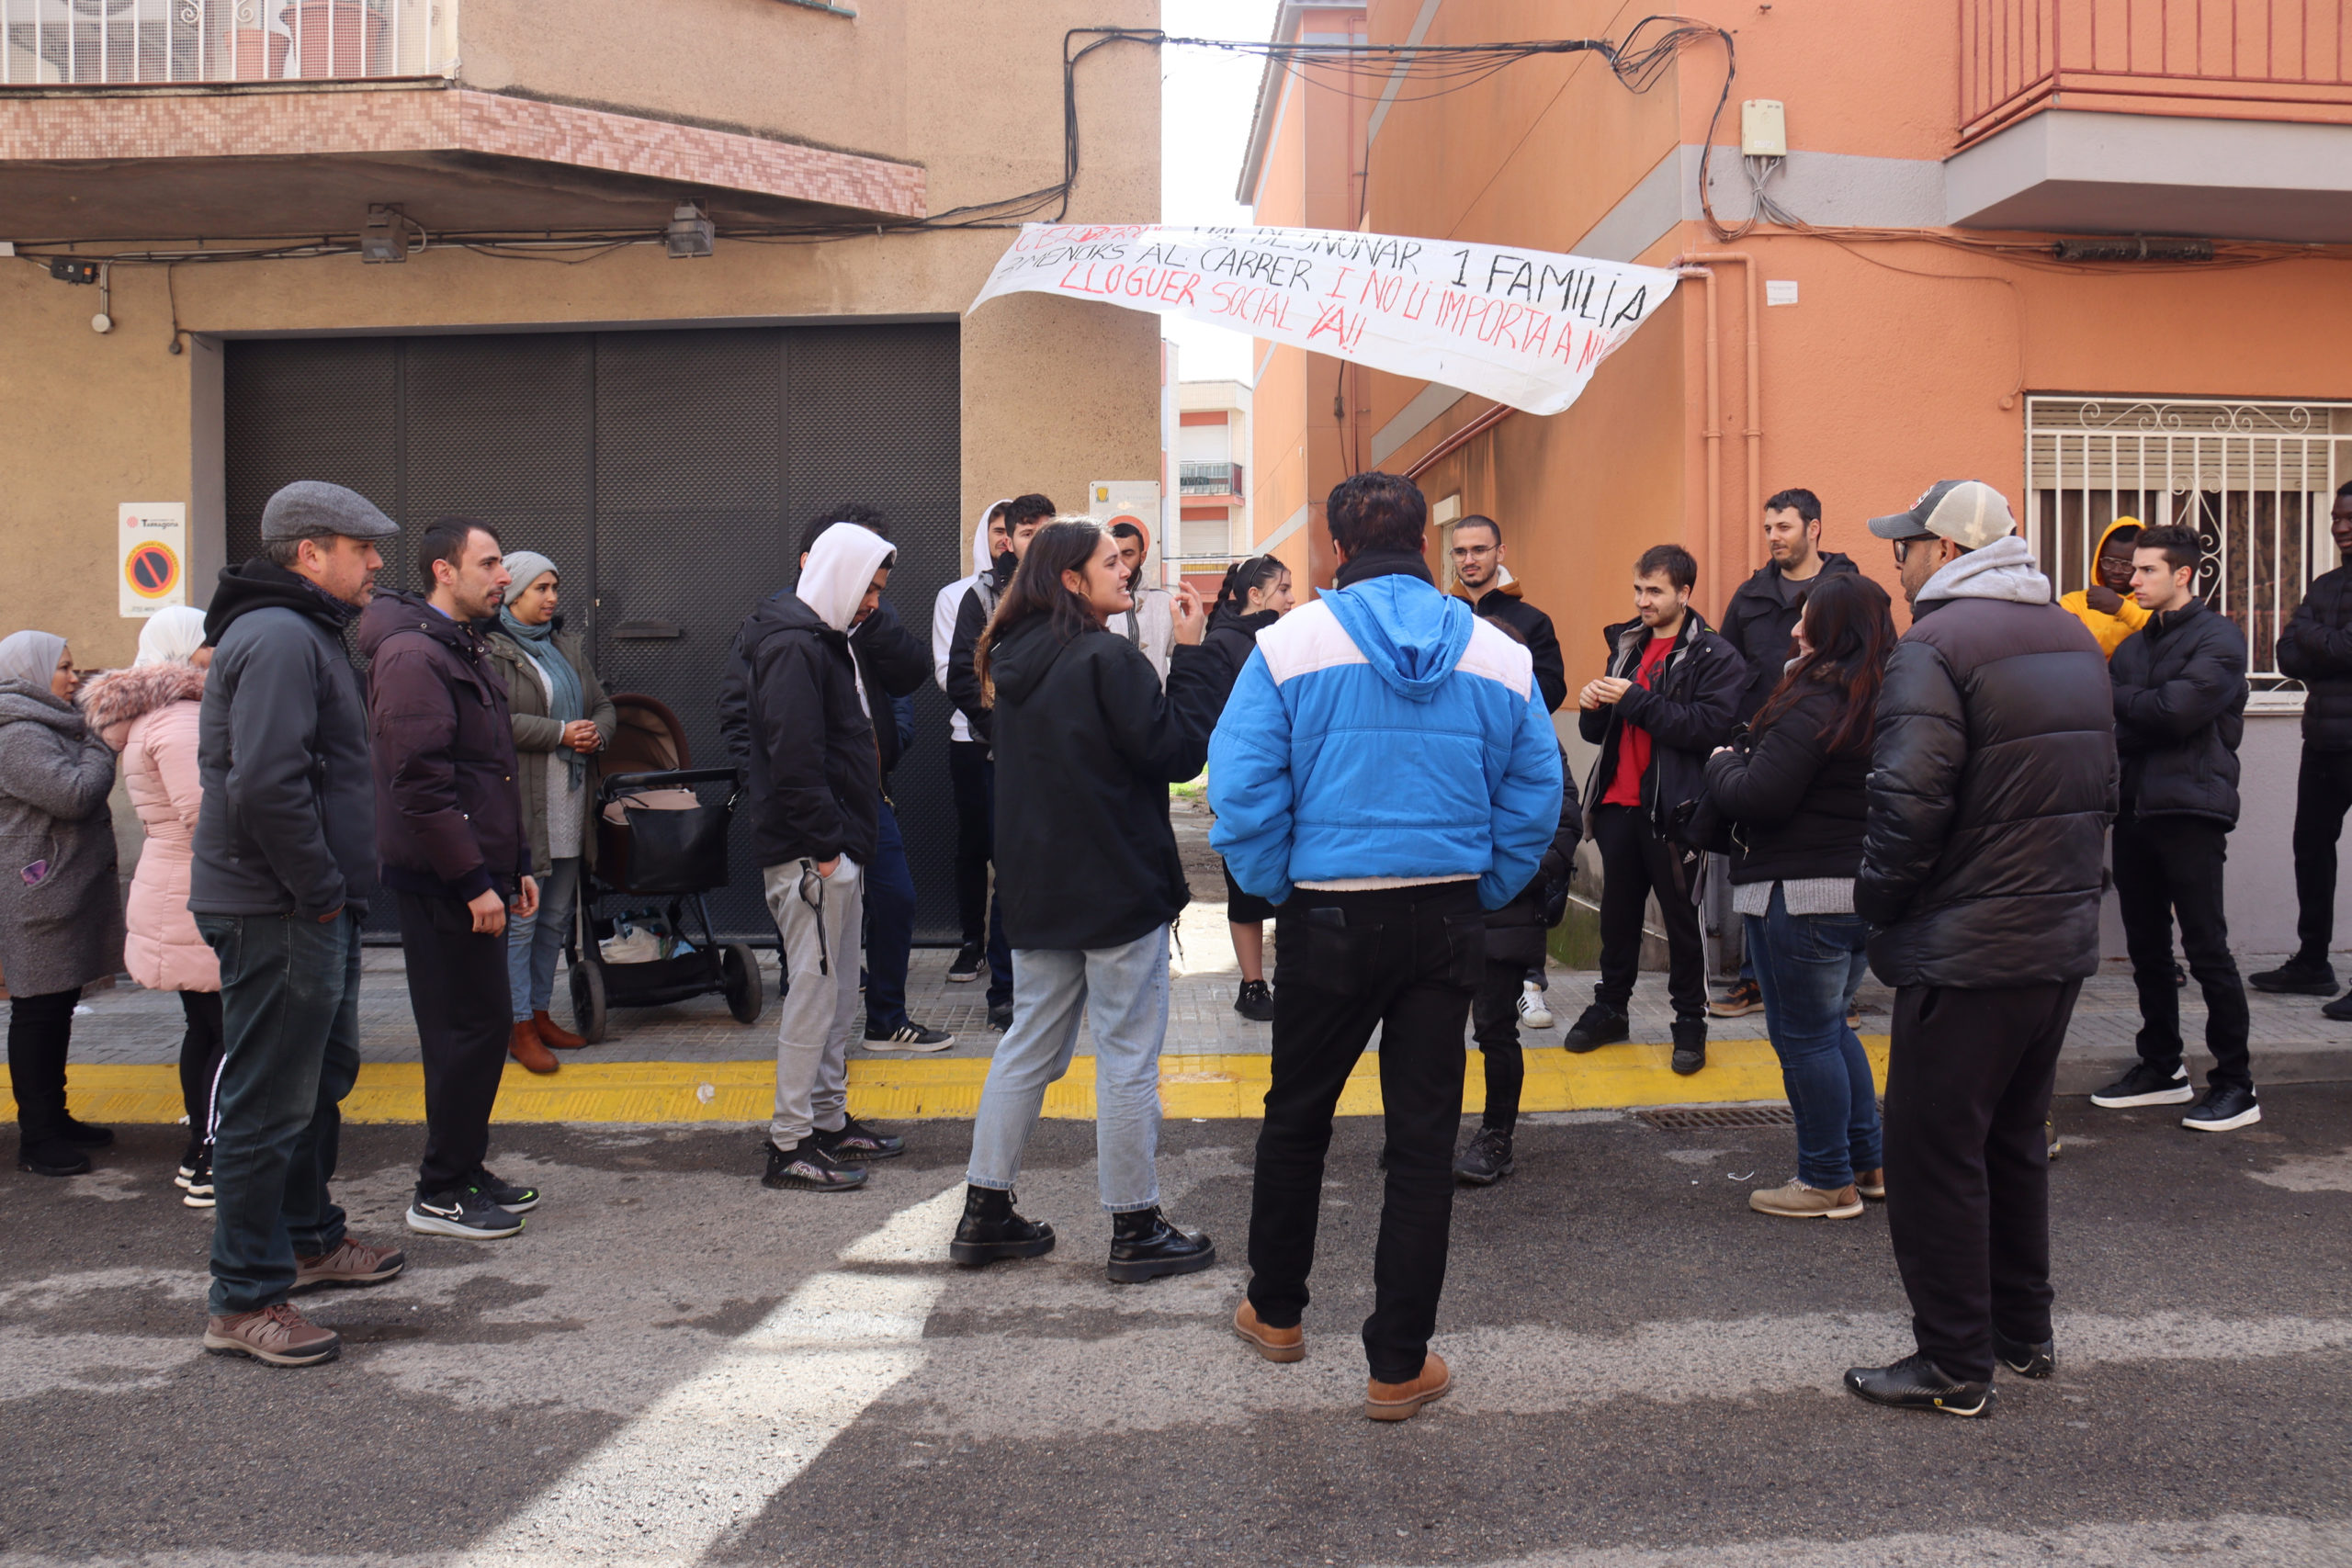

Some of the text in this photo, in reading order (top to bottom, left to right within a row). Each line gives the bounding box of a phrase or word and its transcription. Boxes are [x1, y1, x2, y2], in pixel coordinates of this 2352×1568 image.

[1200, 246, 1312, 292] CARRER
[1325, 265, 1356, 299] I
[1359, 269, 1403, 313] NO
[1452, 250, 1469, 288] 1
[1059, 263, 1367, 354] LLOGUER SOCIAL YA!!
